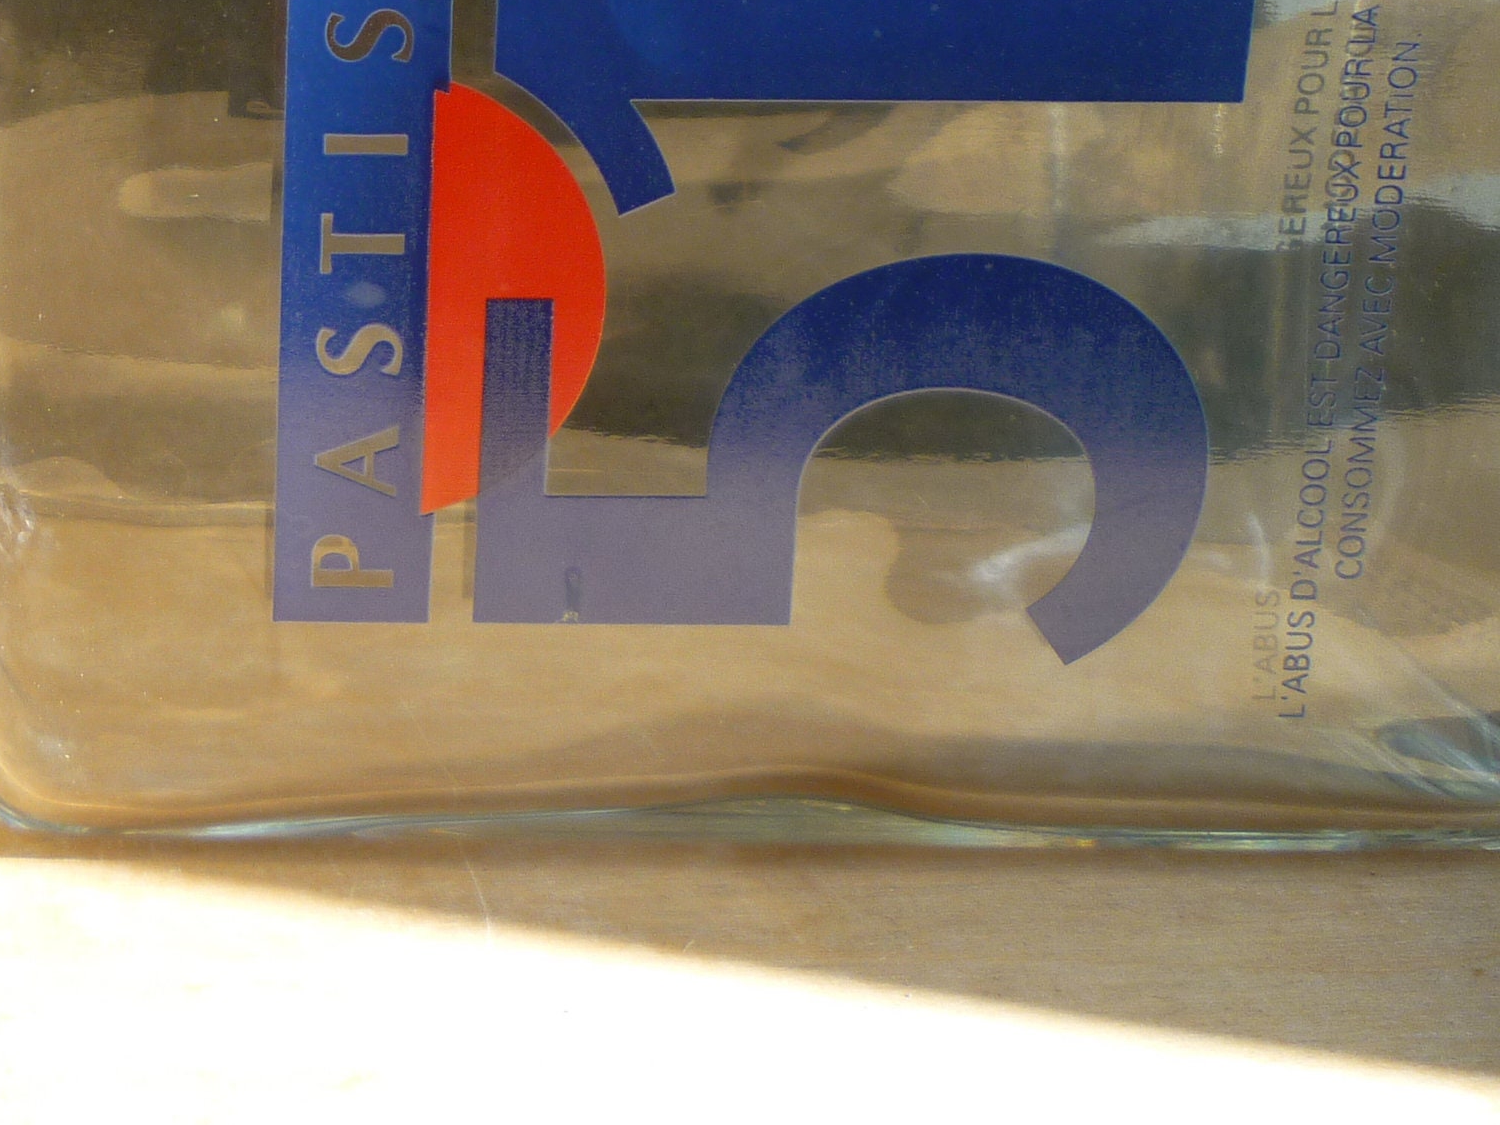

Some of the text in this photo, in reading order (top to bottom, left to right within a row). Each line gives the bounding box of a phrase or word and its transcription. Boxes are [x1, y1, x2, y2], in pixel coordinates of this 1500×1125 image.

[1351, 4, 1381, 45] LA
[1336, 48, 1373, 148] POUR
[310, 8, 415, 589] PASTIS
[1314, 161, 1362, 361] DANGEREUX
[1359, 275, 1394, 357] AVEC
[1306, 373, 1338, 427] EST
[1289, 438, 1334, 601] D'ALCOOL
[1334, 366, 1385, 581] CONSOMMEZ
[1278, 611, 1317, 720] L'ABUS
